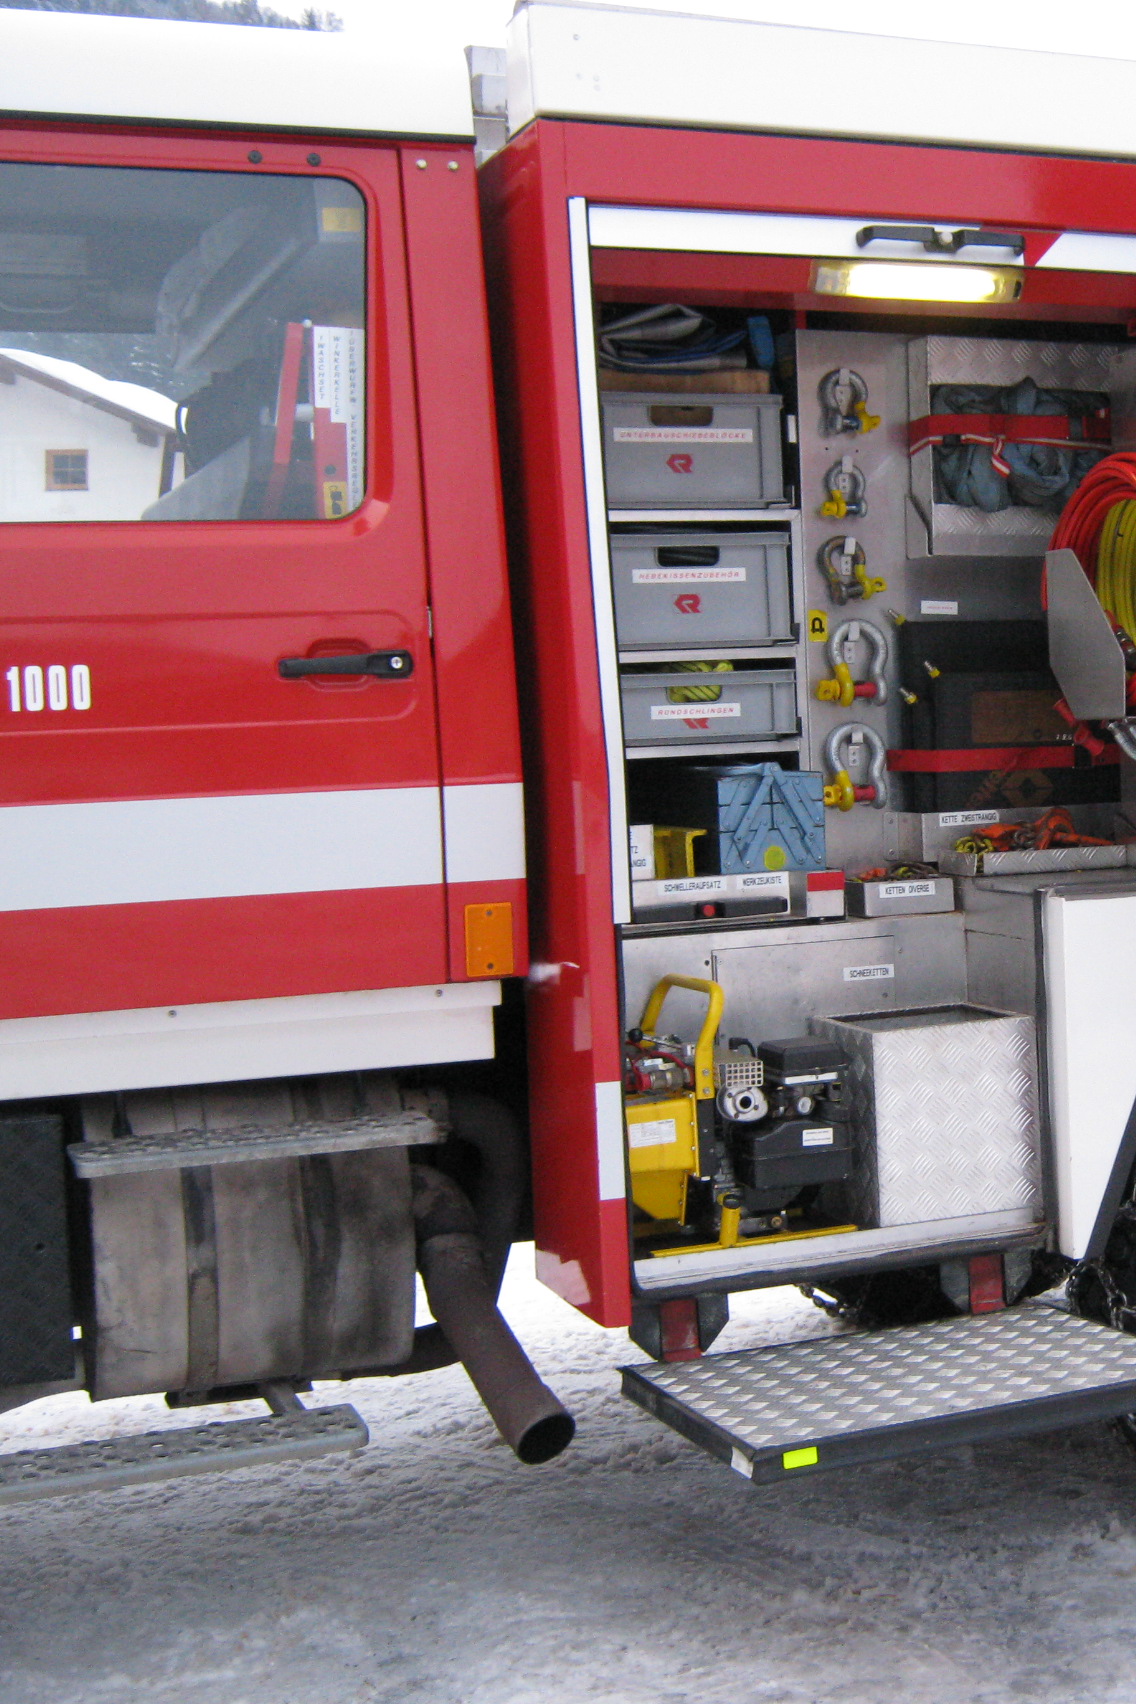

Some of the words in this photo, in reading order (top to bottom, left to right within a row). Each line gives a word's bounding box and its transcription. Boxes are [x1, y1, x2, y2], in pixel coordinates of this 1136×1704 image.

[6, 664, 91, 712] 1000
[657, 707, 735, 716] RUNDSCHLINGEN
[941, 815, 958, 824] KETTE
[885, 885, 906, 895] KETTEN
[908, 884, 930, 894] DIVERSE
[849, 967, 889, 978] SCHNEEKETTEN
